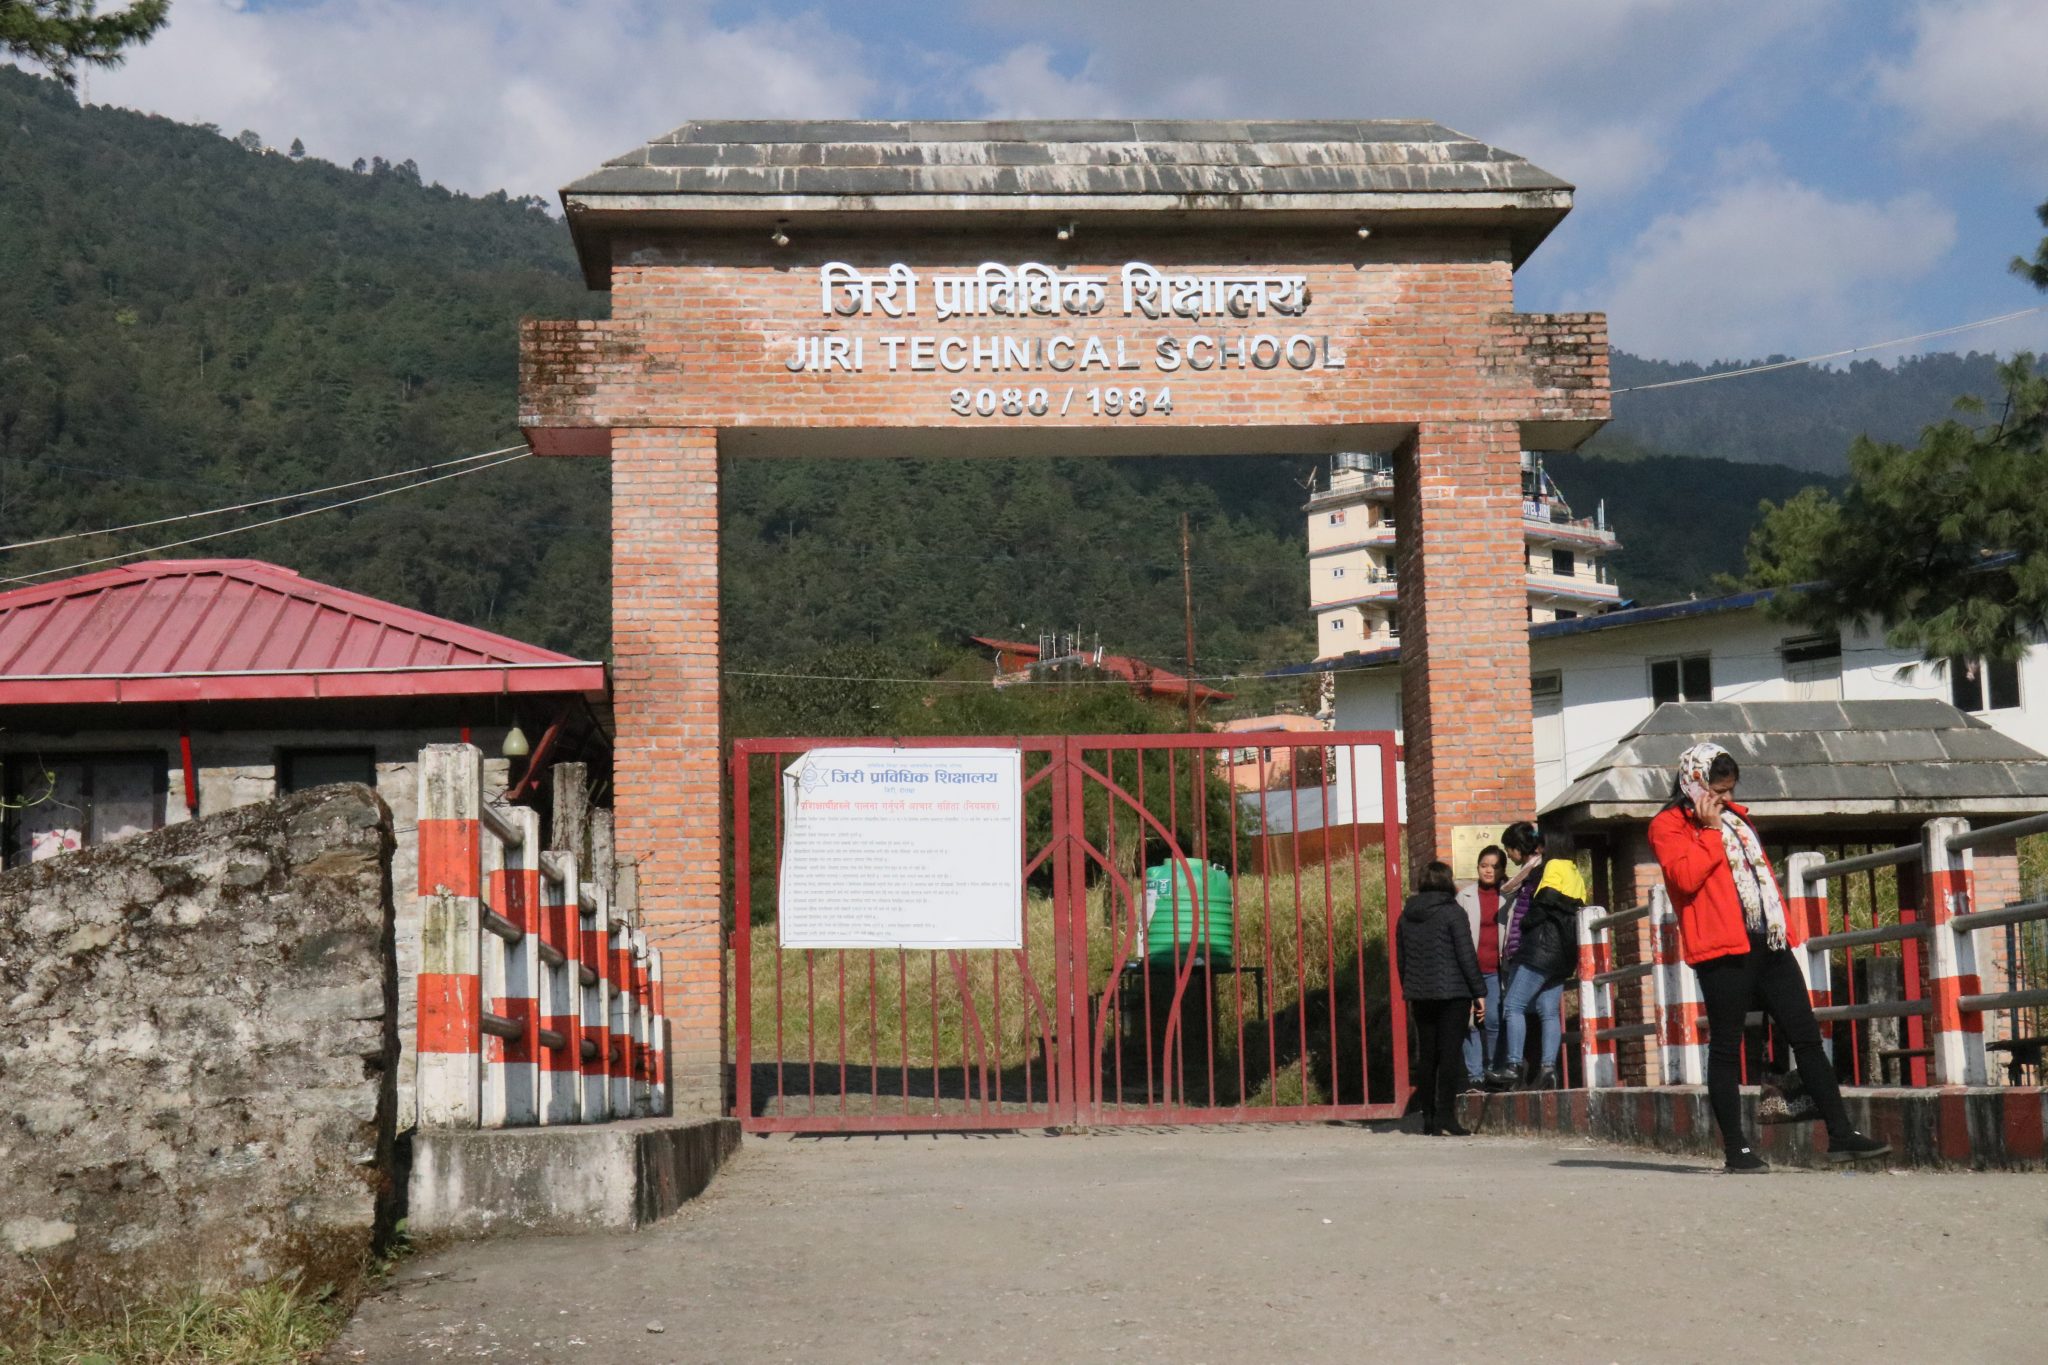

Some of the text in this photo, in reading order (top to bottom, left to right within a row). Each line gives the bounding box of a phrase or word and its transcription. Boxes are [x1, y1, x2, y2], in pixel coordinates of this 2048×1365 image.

[820, 262, 1307, 321] जिरी प्राविधिक शिक्षालय
[785, 334, 1346, 373] JIRI TECHNICAL SCHOOL
[1086, 386, 1174, 417] 1984
[831, 769, 998, 785] जिरी प्राविधिक शिक्षालय
